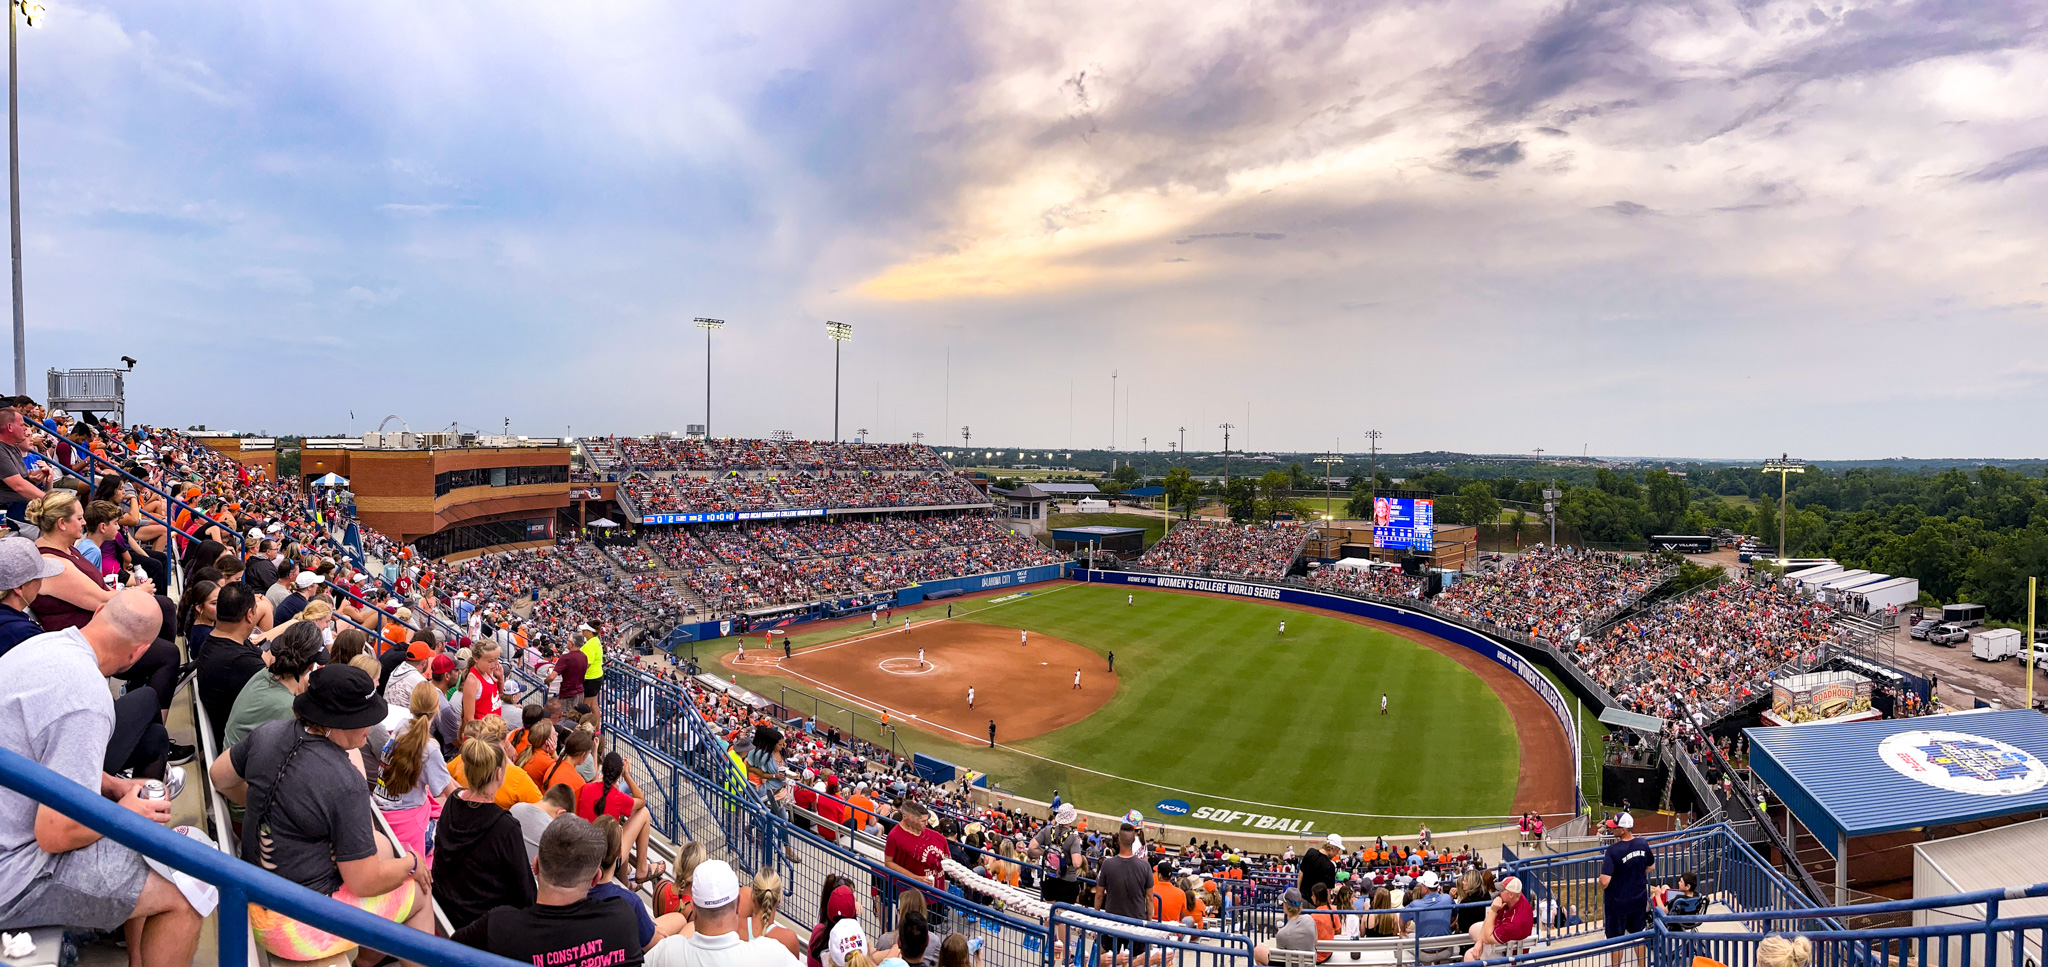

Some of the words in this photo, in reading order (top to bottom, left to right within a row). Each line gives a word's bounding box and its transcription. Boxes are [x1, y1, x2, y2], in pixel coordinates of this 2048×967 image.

[1002, 575, 1011, 584] CITY
[1157, 577, 1193, 589] WOMEN'S
[1194, 581, 1226, 593] COLLEGE
[1227, 584, 1253, 596] WORLD
[1254, 587, 1280, 600] SERIES
[1813, 689, 1854, 704] ROADHOUSE
[1158, 803, 1187, 814] NCAA
[1191, 806, 1315, 835] SOFTBALL
[532, 954, 544, 967] IN
[546, 939, 602, 965] CONSTANT
[580, 949, 625, 967] GROWTH
